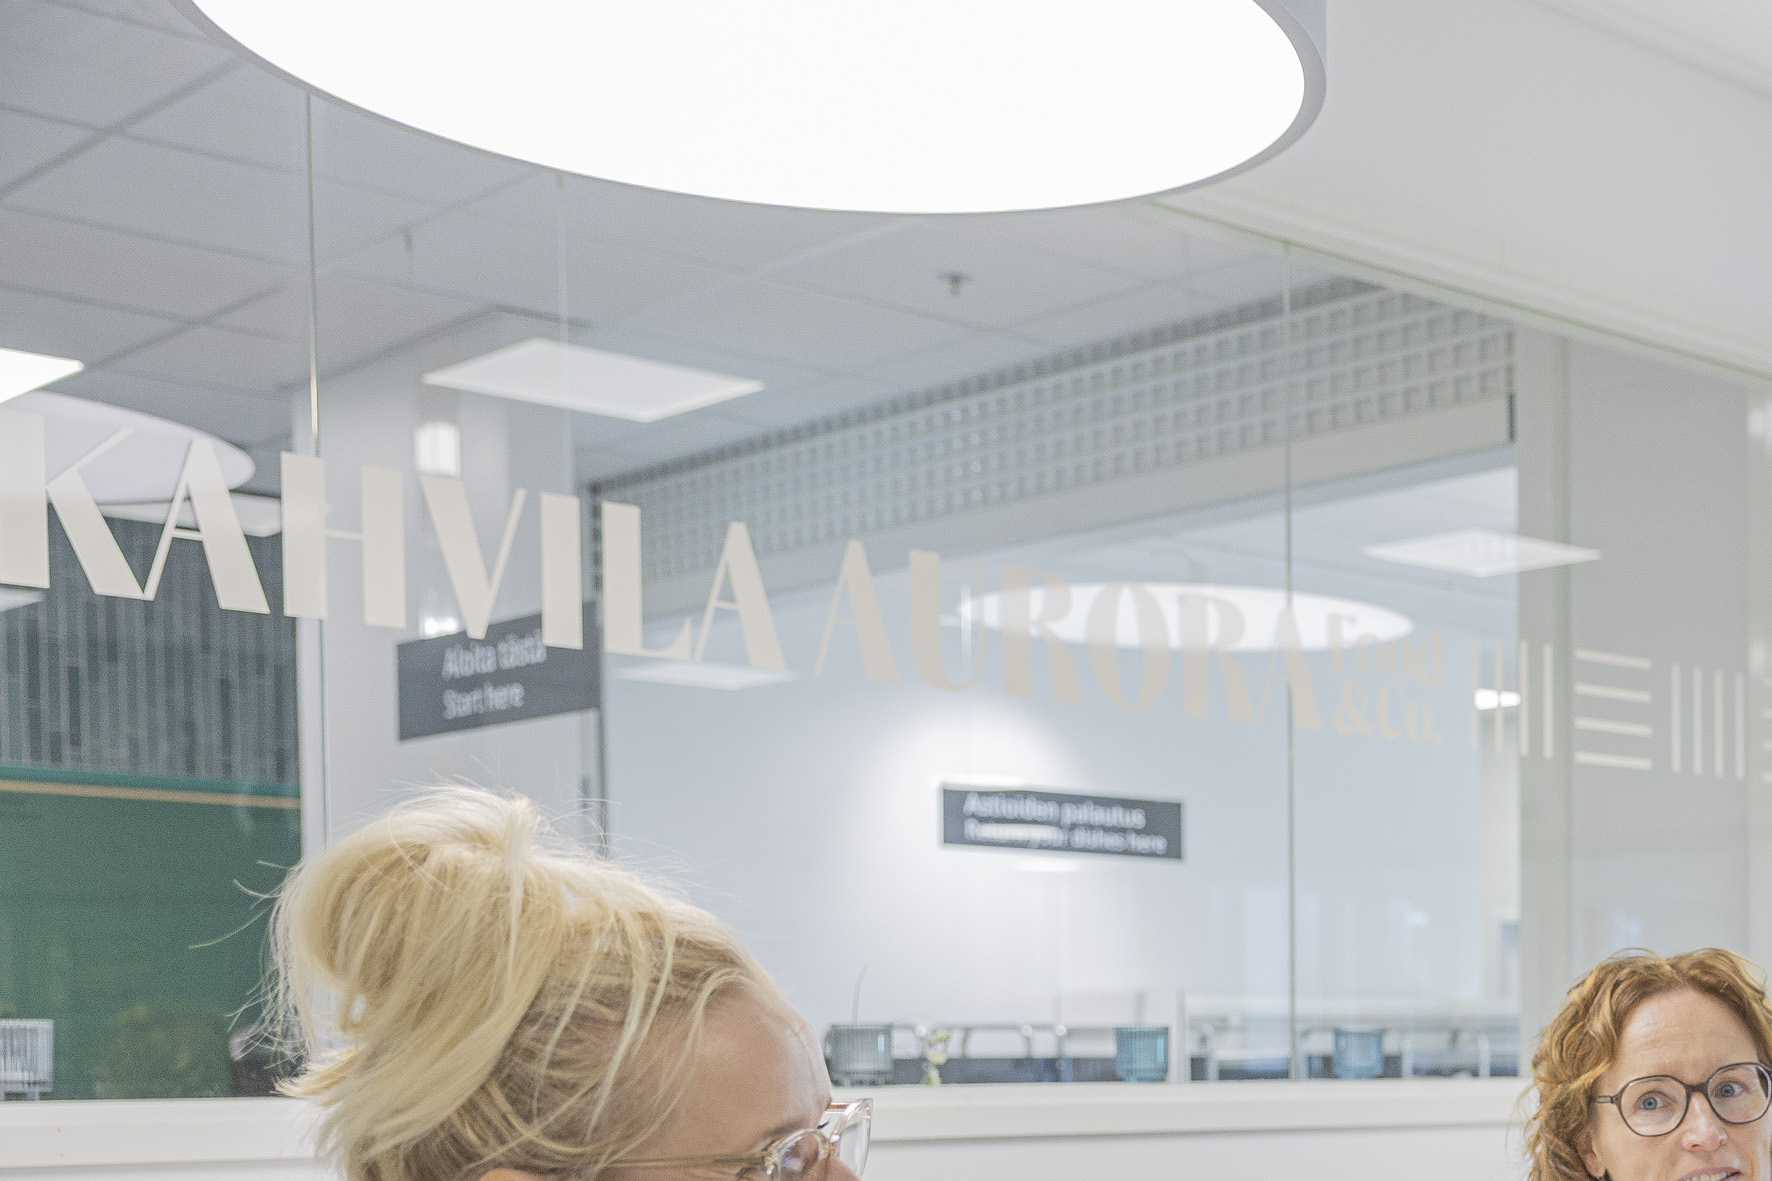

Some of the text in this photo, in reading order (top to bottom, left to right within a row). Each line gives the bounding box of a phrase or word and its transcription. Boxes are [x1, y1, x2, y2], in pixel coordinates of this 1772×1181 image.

[0, 411, 1322, 731] KAHVILA AURORA
[1327, 613, 1442, 688] Food
